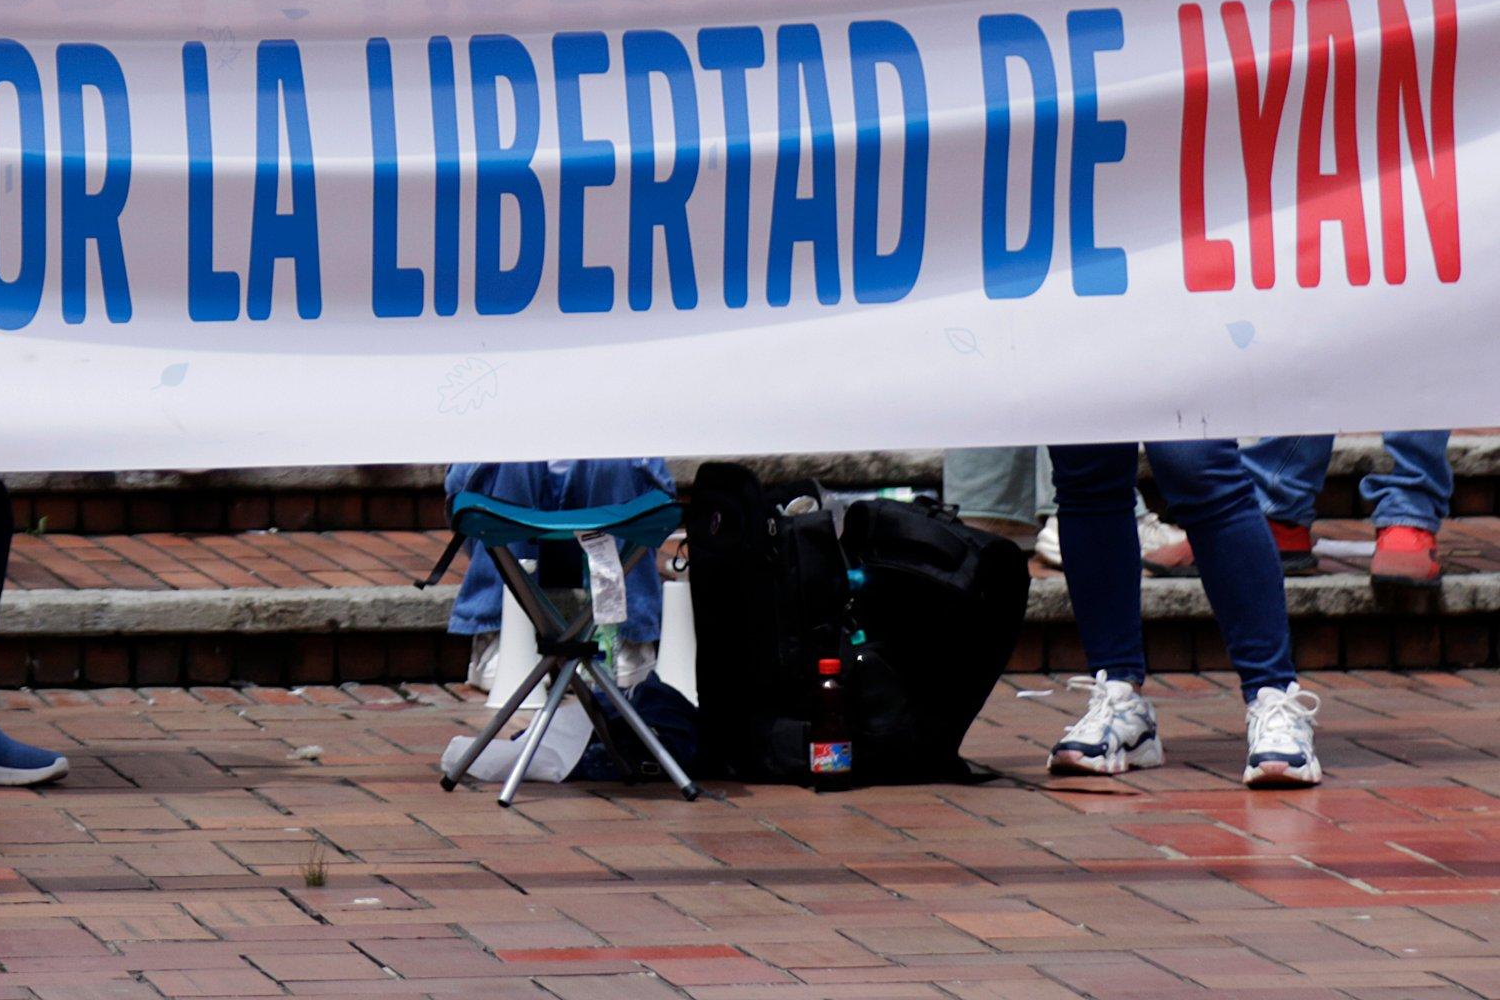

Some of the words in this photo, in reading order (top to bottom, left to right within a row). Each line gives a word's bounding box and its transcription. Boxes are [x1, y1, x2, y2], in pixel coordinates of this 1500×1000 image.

[182, 38, 323, 323] LA
[365, 19, 930, 318] LIBERTAD
[977, 7, 1128, 300] DE
